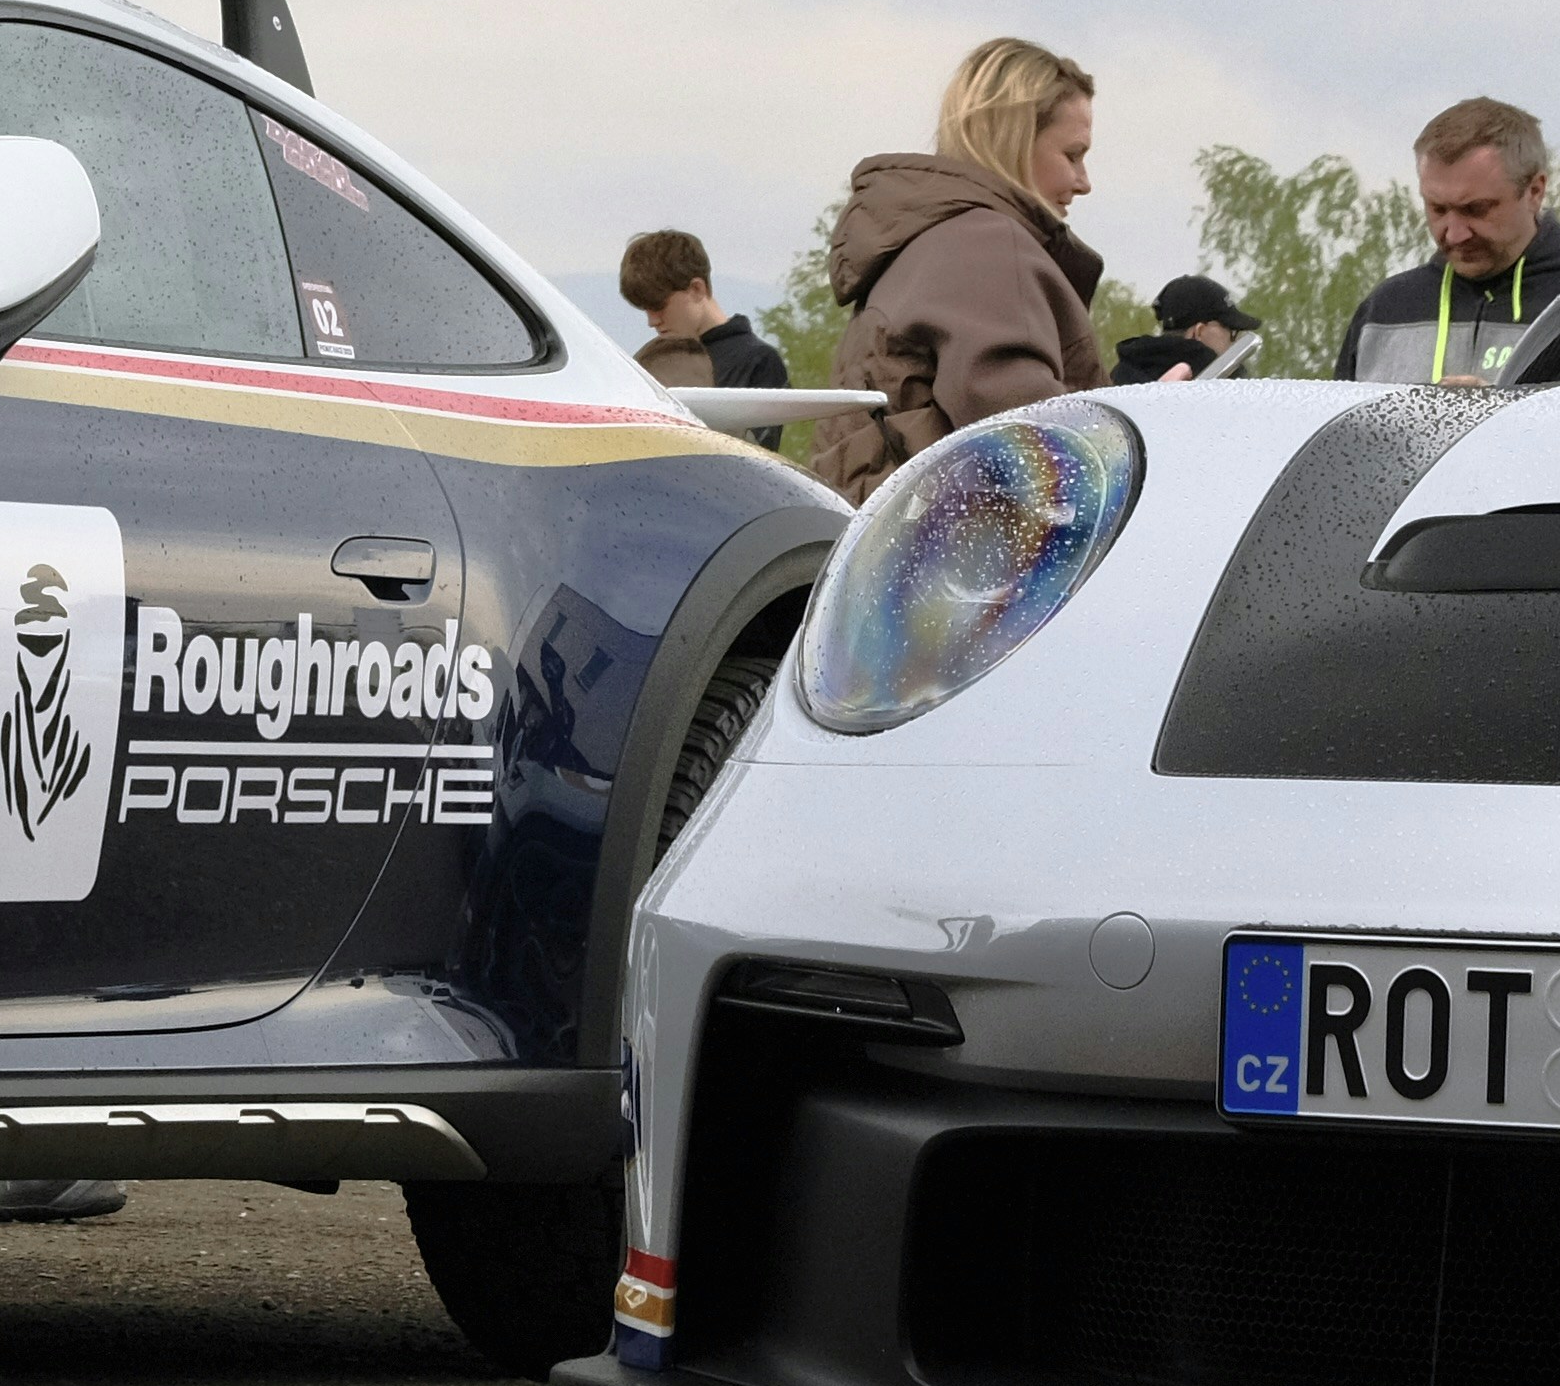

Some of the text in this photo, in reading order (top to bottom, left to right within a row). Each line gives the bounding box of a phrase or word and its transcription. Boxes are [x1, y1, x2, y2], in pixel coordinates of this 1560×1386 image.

[312, 298, 344, 337] 02
[131, 606, 494, 741] Roughroads
[117, 765, 494, 825] PORSCHE
[1304, 964, 1532, 1104] ROT
[1236, 1053, 1289, 1095] CZ
